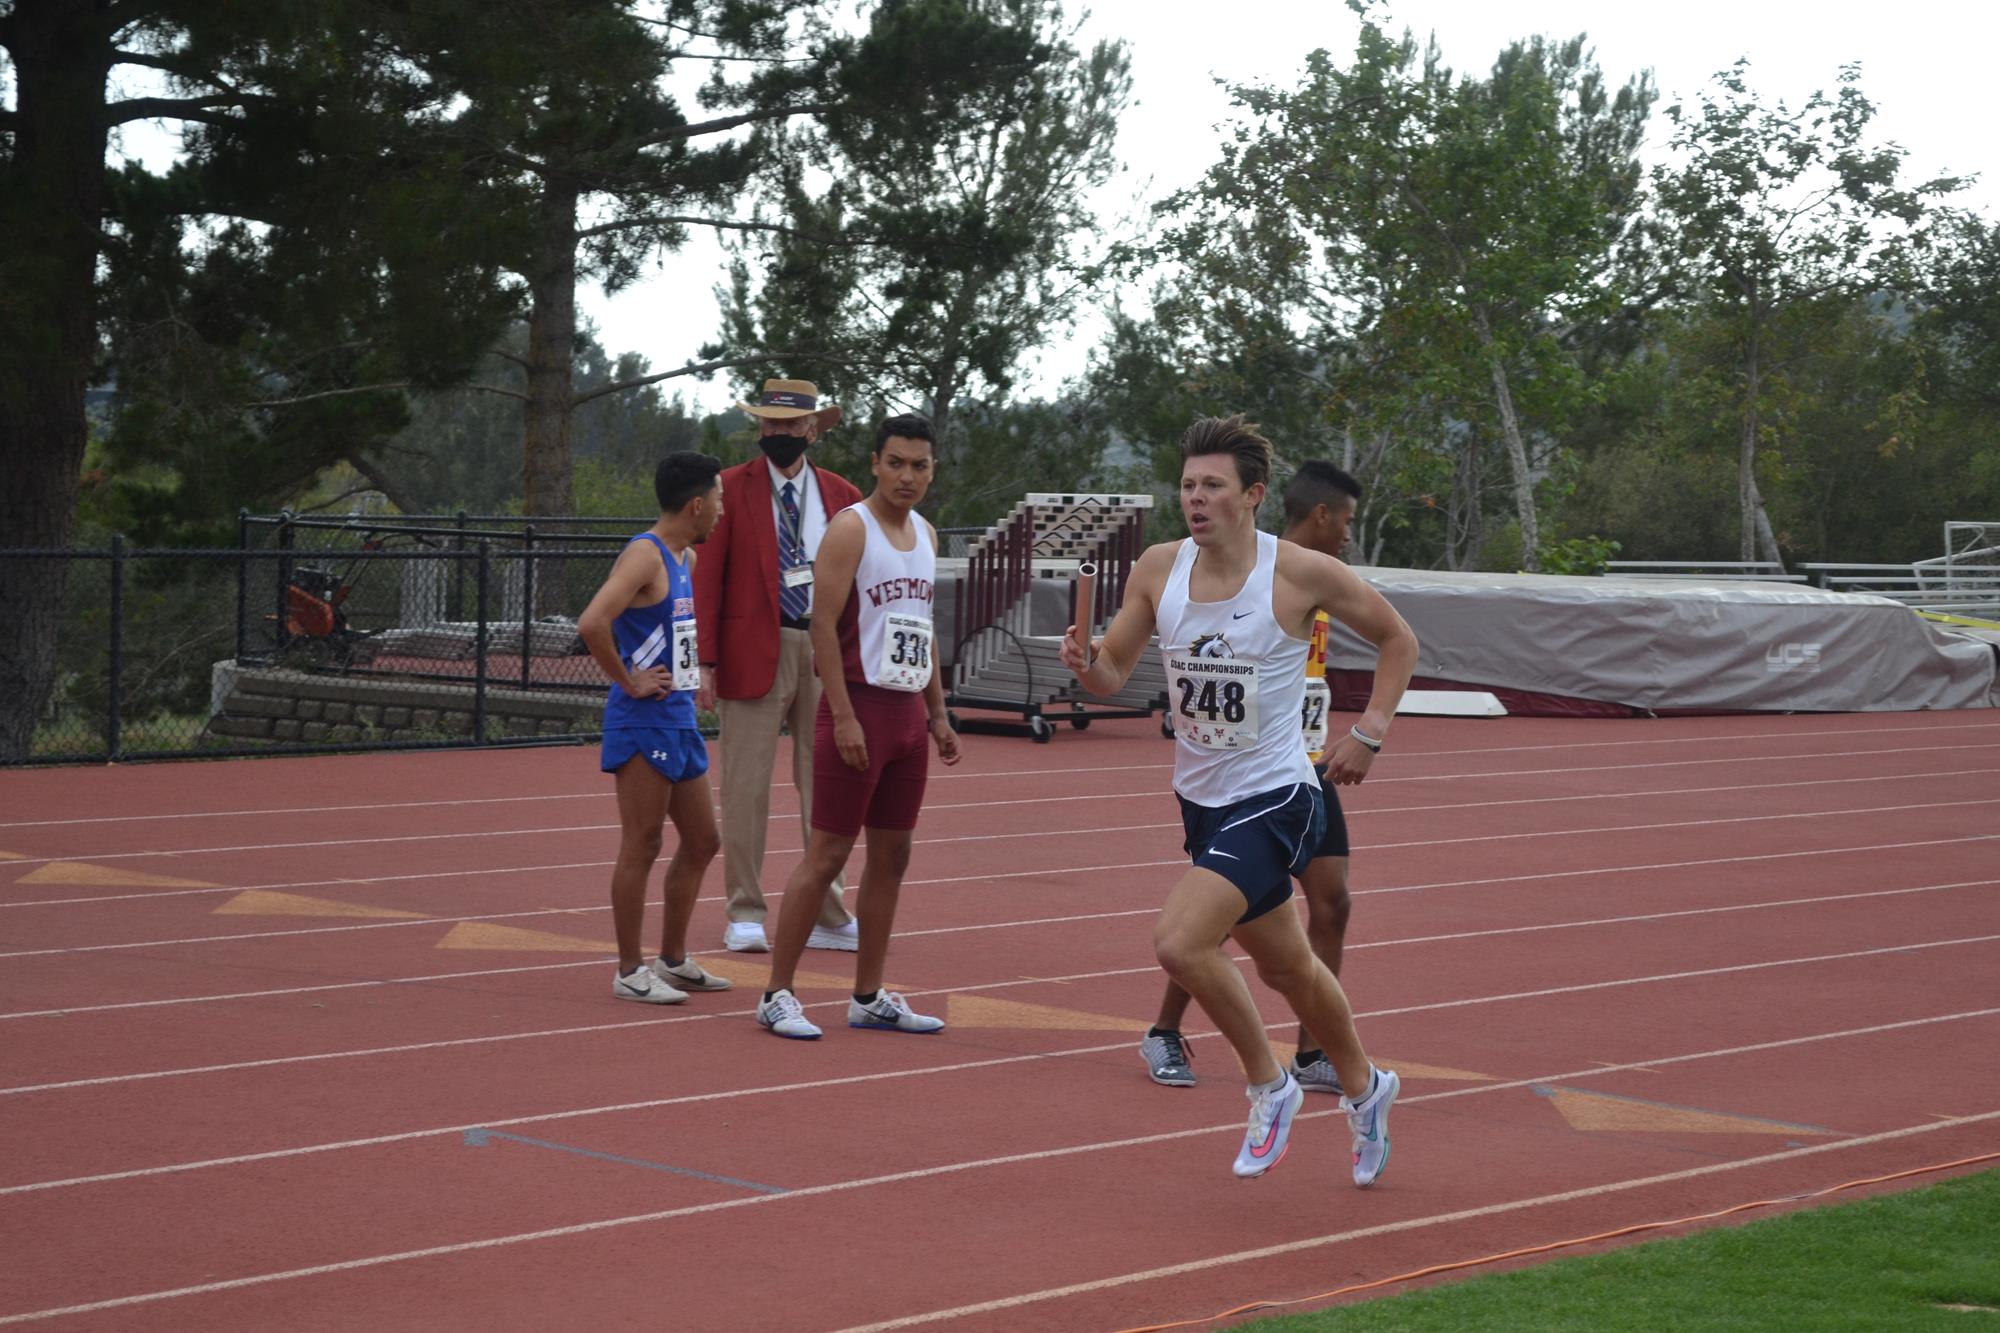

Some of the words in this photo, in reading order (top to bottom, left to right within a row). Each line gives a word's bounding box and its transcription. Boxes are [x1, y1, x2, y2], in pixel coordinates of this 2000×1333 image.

[1766, 643, 1821, 664] UCS
[1187, 662, 1254, 675] CHAMPIONSHIPS
[1177, 677, 1245, 723] 248
